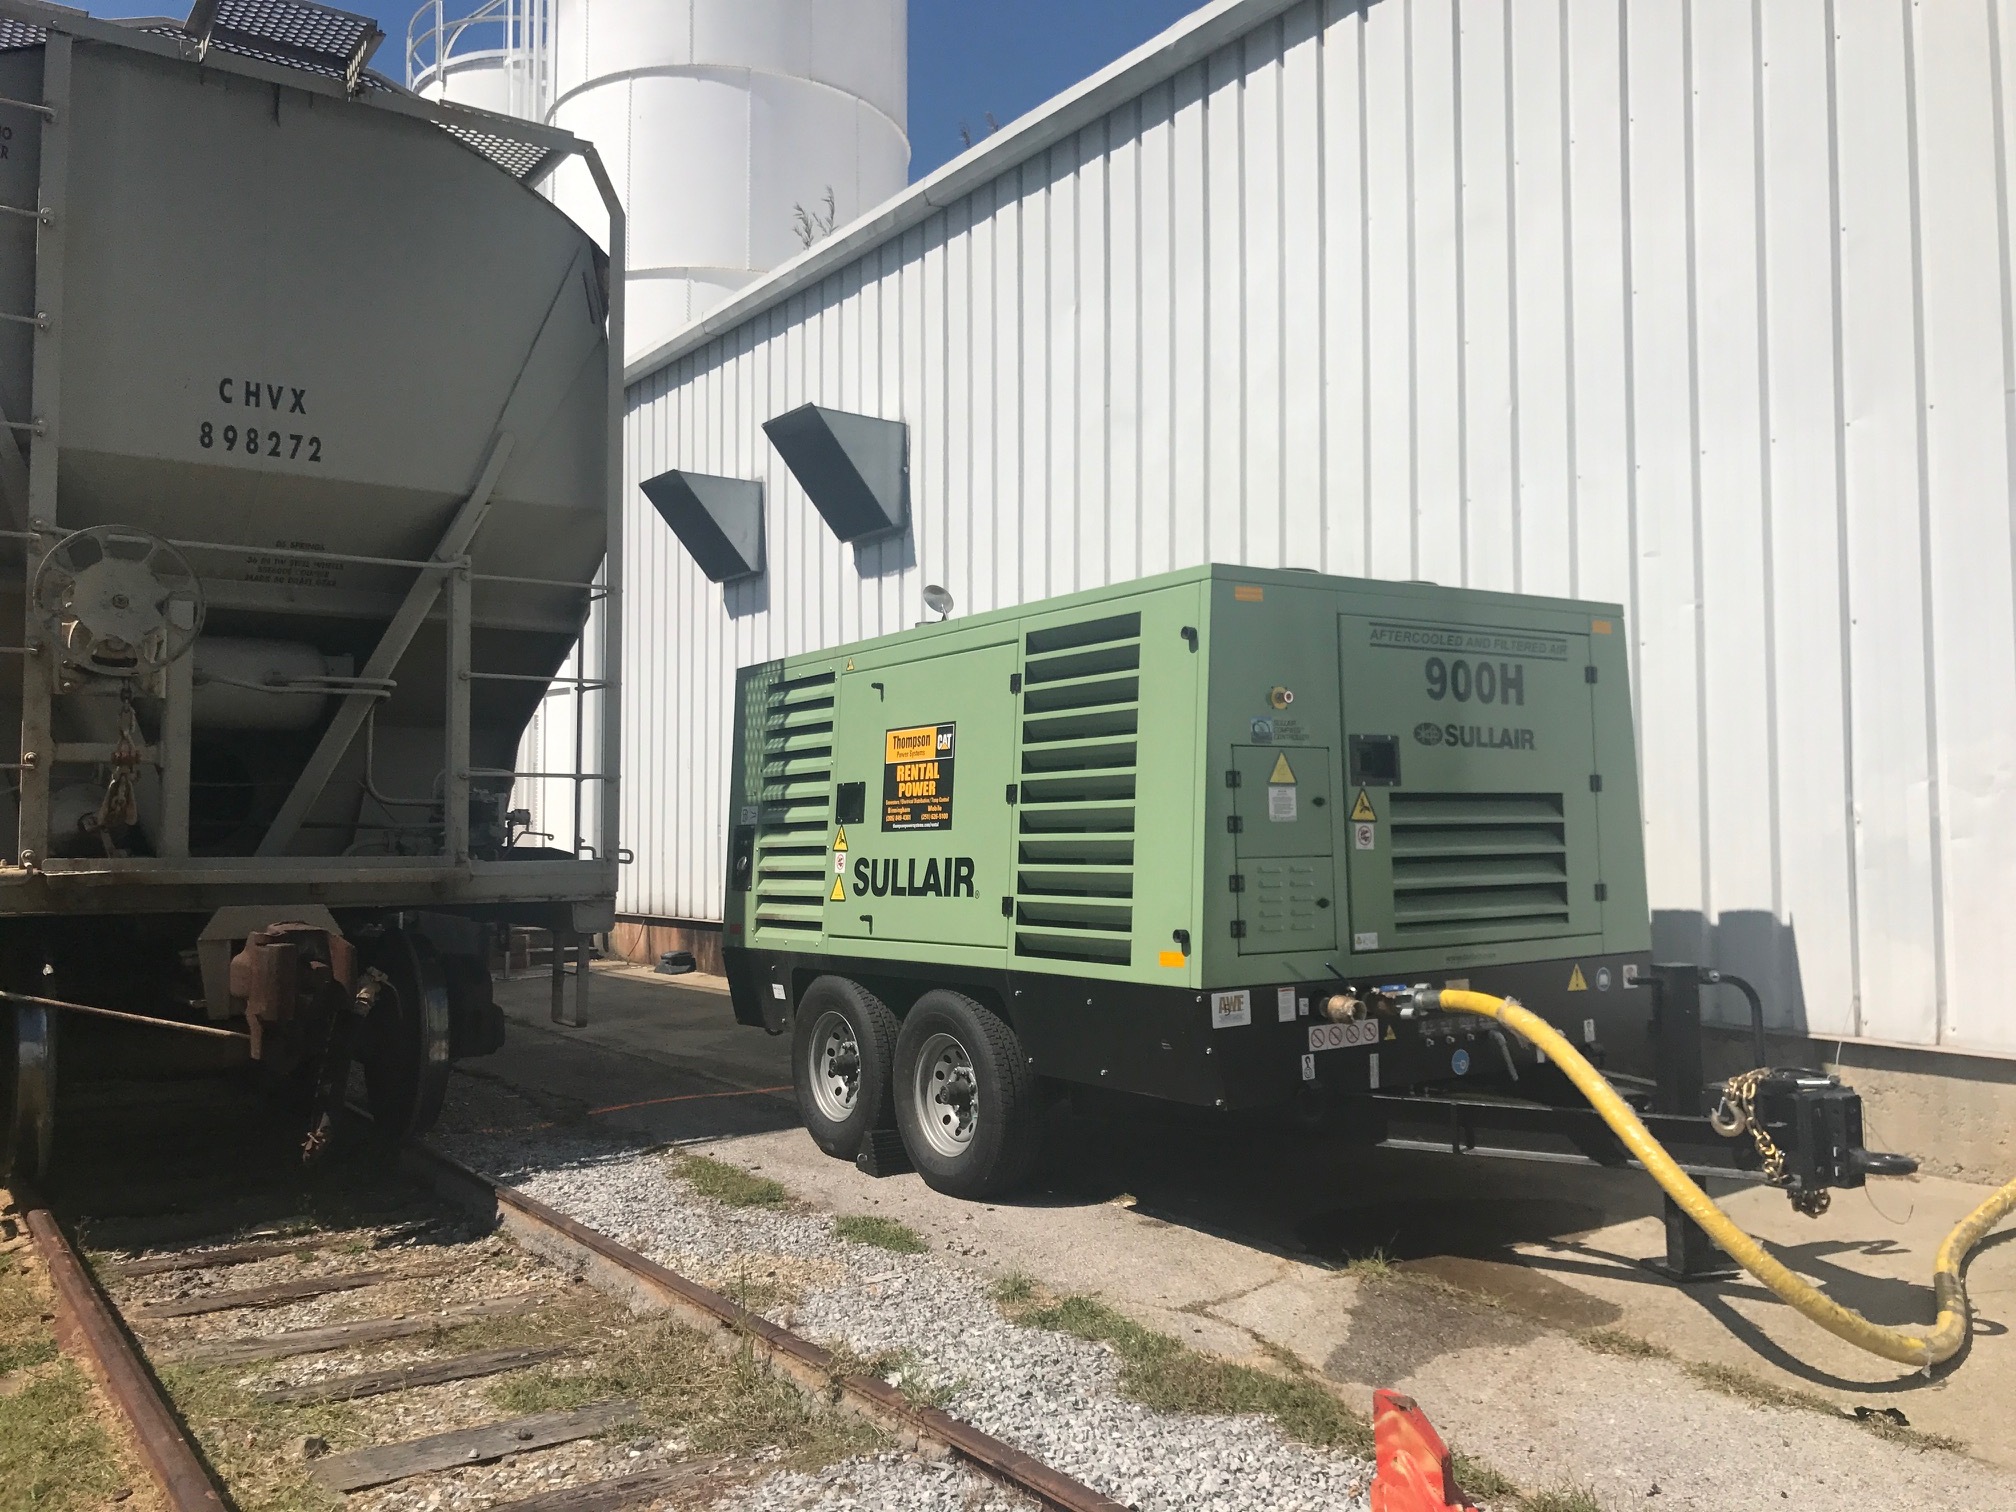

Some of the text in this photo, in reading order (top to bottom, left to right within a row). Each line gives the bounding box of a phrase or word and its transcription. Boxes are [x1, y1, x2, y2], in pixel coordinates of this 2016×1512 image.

[219, 377, 307, 415] CHVX
[199, 421, 322, 463] 898272
[1370, 628, 1568, 655] AFTERCOOLED AND FILTERED AIR
[1425, 656, 1524, 706] 900H
[893, 734, 931, 750] Thompson
[937, 733, 952, 750] CAT
[1444, 723, 1536, 751] SULLAIR
[909, 750, 926, 758] Systems
[896, 762, 940, 782] RENTAL
[898, 781, 936, 798] POWER
[927, 804, 942, 812] Mobile
[853, 857, 975, 898] SULLAIR
